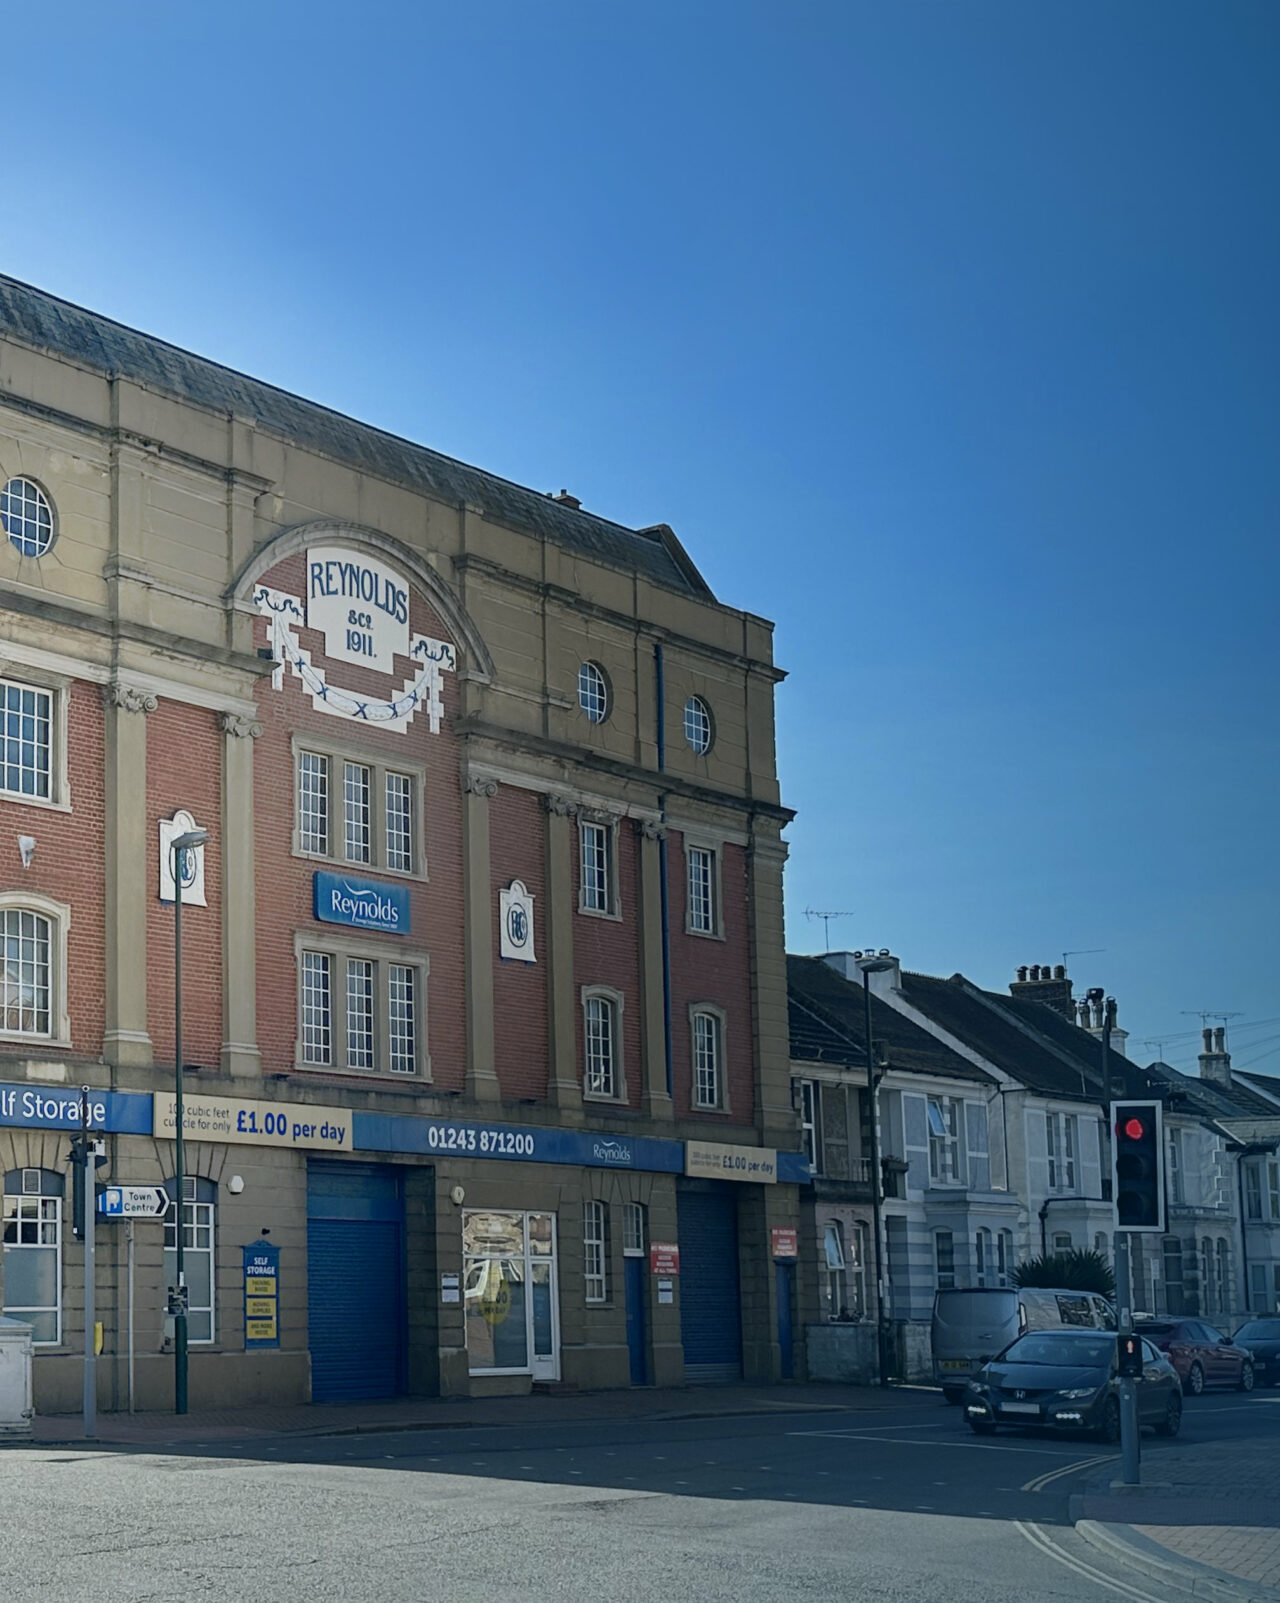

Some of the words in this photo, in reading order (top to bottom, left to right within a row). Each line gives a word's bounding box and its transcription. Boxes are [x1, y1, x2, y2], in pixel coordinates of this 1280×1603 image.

[310, 561, 408, 624] REYNOLDS
[331, 889, 399, 923] Reynolds
[22, 1091, 105, 1127] Storage
[187, 1105, 211, 1117] cubic
[213, 1107, 230, 1118] feet
[198, 1118, 211, 1130] for
[212, 1121, 231, 1134] only
[236, 1110, 287, 1136] £1.00
[292, 1122, 317, 1142] per
[320, 1122, 346, 1144] day
[428, 1126, 476, 1151] 01243
[480, 1130, 534, 1155] 871200
[593, 1143, 631, 1163] Reynolds
[723, 1155, 747, 1170] £1.00
[129, 1192, 152, 1201] Town
[124, 1203, 155, 1212] Centre
[253, 1257, 268, 1265] SELF
[246, 1266, 275, 1275] STORAGE
